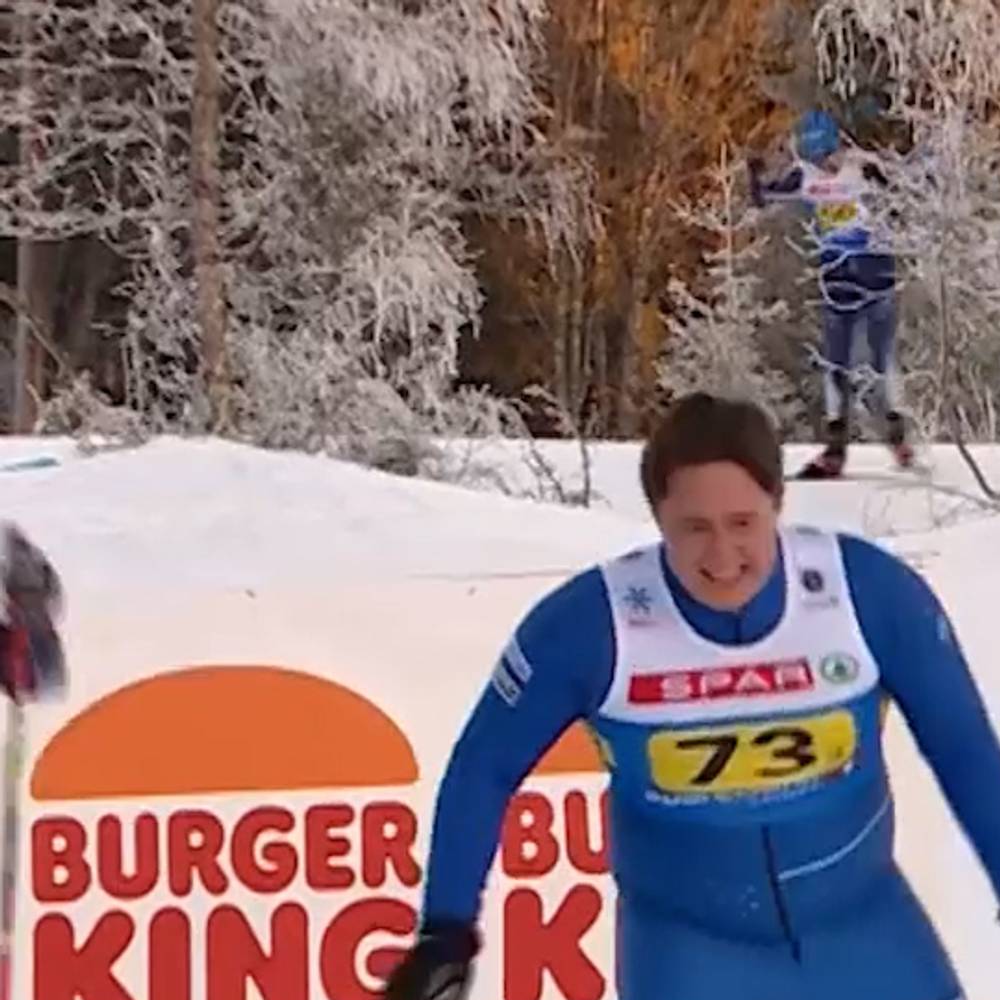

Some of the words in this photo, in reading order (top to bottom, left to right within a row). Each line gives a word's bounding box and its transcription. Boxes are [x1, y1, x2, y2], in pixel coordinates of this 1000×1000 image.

[659, 660, 811, 700] SPAR
[675, 727, 817, 786] 73
[31, 801, 423, 902] BURGER
